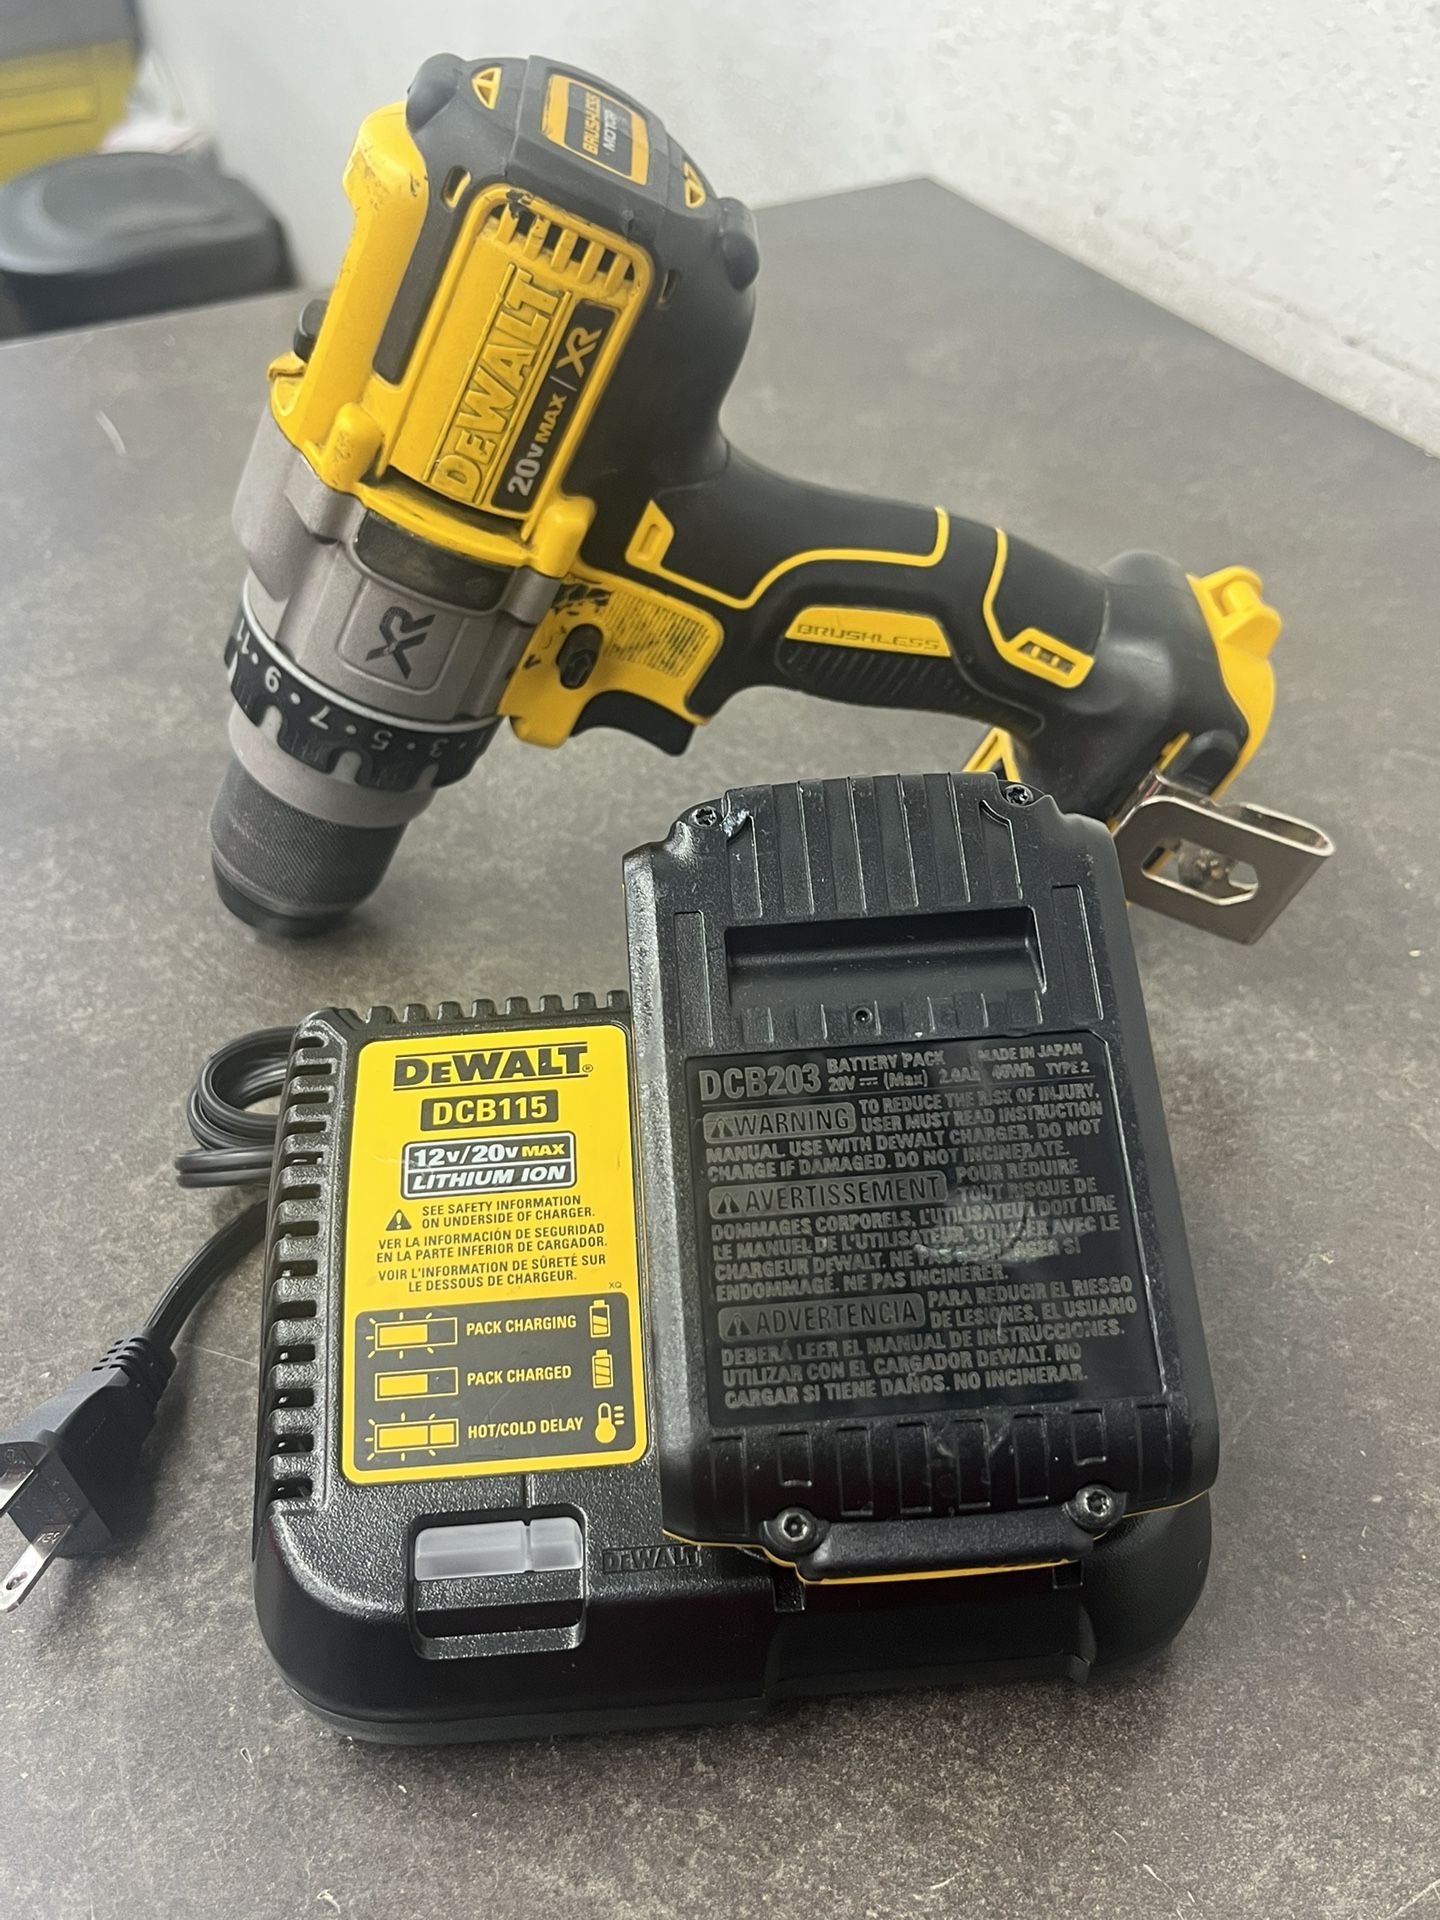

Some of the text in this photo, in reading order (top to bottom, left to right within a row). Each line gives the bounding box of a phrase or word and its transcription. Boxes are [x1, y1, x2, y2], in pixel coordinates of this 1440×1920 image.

[430, 268, 566, 500] DEWALT
[535, 393, 567, 443] MAX
[555, 327, 602, 378] XR
[797, 624, 940, 650] BRUSHLESS
[394, 1046, 588, 1086] DEWALT
[826, 1050, 946, 1073] BATTERY PACK
[978, 1043, 1083, 1061] MADE IN JAPAN
[699, 1063, 822, 1101] DCB203
[828, 1075, 856, 1091] 20V
[883, 1069, 928, 1090] (Max)
[1045, 1061, 1079, 1076] TYPE
[1080, 1060, 1090, 1073] 2
[432, 1095, 548, 1126] DCB115
[859, 1099, 880, 1114] TO
[883, 1093, 942, 1113] REDUCE
[945, 1091, 975, 1108] THE
[1016, 1086, 1035, 1102] OF
[1038, 1083, 1100, 1101] INJURY.
[734, 1107, 849, 1136] WARNING
[861, 1101, 1103, 1132] USER MUST READ INSTRUCTION
[522, 1143, 565, 1157] MAX
[706, 1119, 1101, 1163] MANUAL. USE WITH DEWALT CHARGER. DO NOT
[707, 1140, 1070, 1182] CHARGE IF DAMAGED. DO NOT INCINERATE.
[955, 1163, 1004, 1183] POUR
[412, 1165, 566, 1191] LITHIUM ION
[745, 1175, 939, 1212] AVERTISSEMENT
[957, 1177, 1098, 1202] TOUT RISQUE DE
[422, 1195, 581, 1216] SEE SAFETY INFORMATION
[422, 1206, 596, 1229] ON UNDERSIDE OF CHARGER.
[711, 1217, 813, 1241] DOMMAGES
[815, 1209, 916, 1232] CORPORELS,
[1039, 1198, 1077, 1217] DOIT
[1081, 1194, 1118, 1212] LIRE
[377, 1236, 608, 1263] EN LA PARTE INFERIOR DE CARGADOR.
[378, 1223, 605, 1250] VER LA INFORMACIÓN DE SEGURIDAD
[712, 1243, 733, 1260] LE
[736, 1237, 813, 1259] MANUEL
[814, 1235, 838, 1254] DE
[1053, 1215, 1097, 1235] AVEC
[1101, 1214, 1121, 1232] LE
[378, 1253, 606, 1281] VOIR L'INFORMATION DE SÛRETÉ SUR
[714, 1257, 810, 1281] CHARGEUR
[889, 1249, 915, 1267] NE
[1064, 1236, 1081, 1255] SI
[409, 1270, 577, 1293] LE DESSOUS DE CHARGEUR.
[843, 1274, 868, 1291] NE
[871, 1271, 907, 1289] PAS
[927, 1275, 1133, 1308] PARA REDUCIR EL RIESGO
[466, 1315, 577, 1336] PACK CHARGING
[756, 1300, 918, 1334] ADVERTENCIA
[929, 1296, 1137, 1329] DE LESIONES, EL USUARIO
[721, 1318, 1125, 1366] DEBERÁ LEER EL MANUAL DE INSTRUCCIONES.
[467, 1365, 572, 1386] PACK CHARGED
[723, 1364, 803, 1387] UTILIZAR
[806, 1360, 845, 1381] CON
[850, 1359, 871, 1377] EL
[873, 1351, 973, 1375] CARGADOR
[1054, 1342, 1082, 1361] NO
[724, 1363, 1088, 1409] CARGAR SI TIENE DAÑOS. NO INCINERAR.
[468, 1417, 584, 1439] HOT/COLD DELAY
